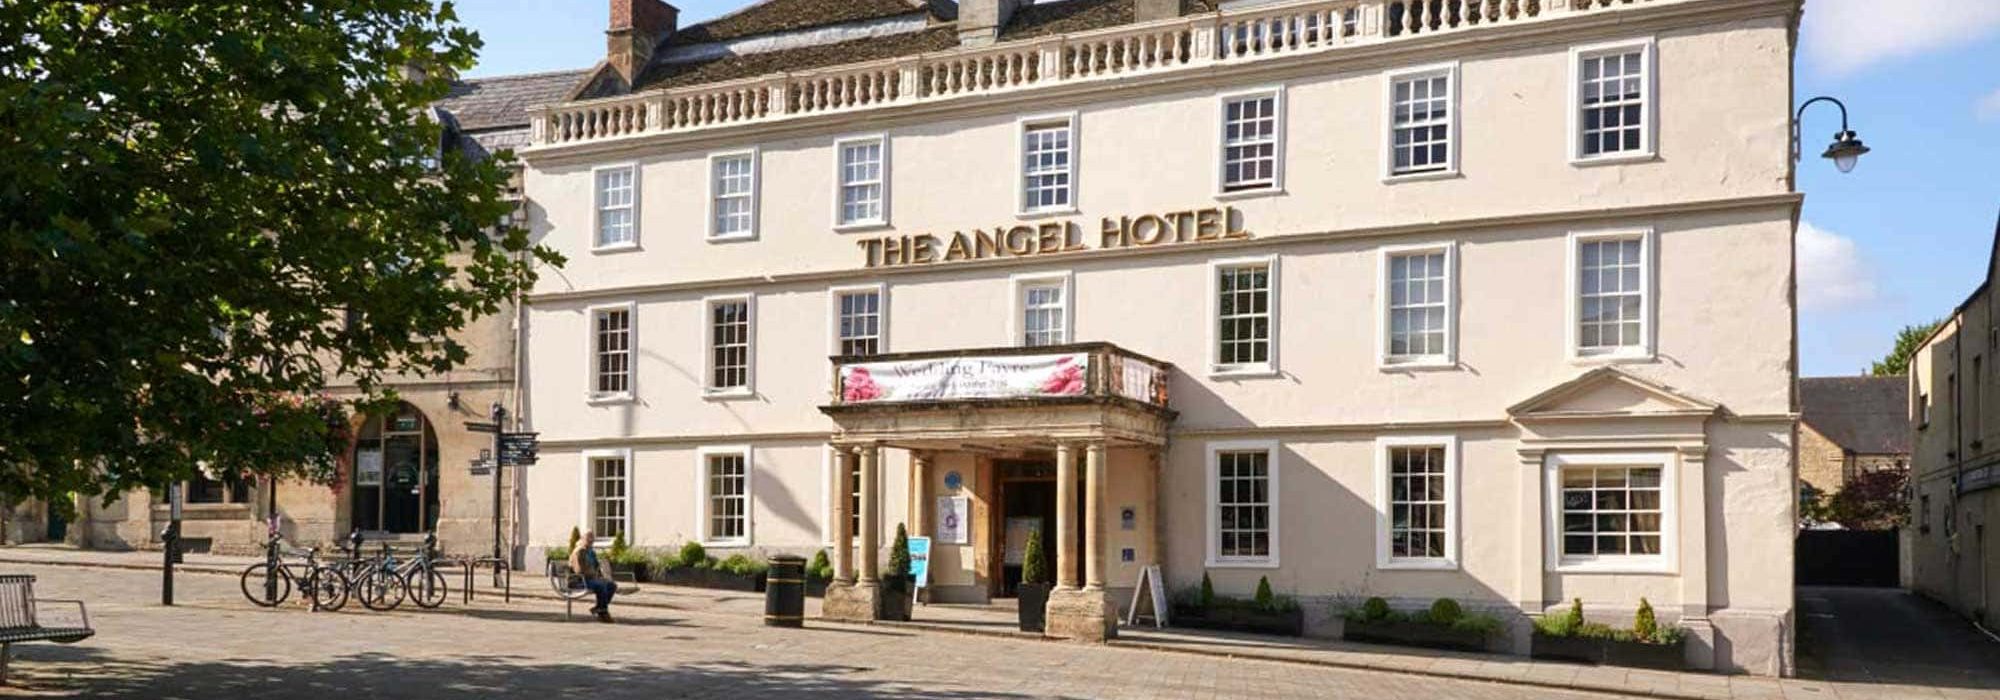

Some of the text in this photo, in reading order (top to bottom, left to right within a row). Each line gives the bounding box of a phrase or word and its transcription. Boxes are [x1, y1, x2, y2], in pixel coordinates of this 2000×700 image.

[857, 206, 1249, 267] THE ANGEL HOTEL
